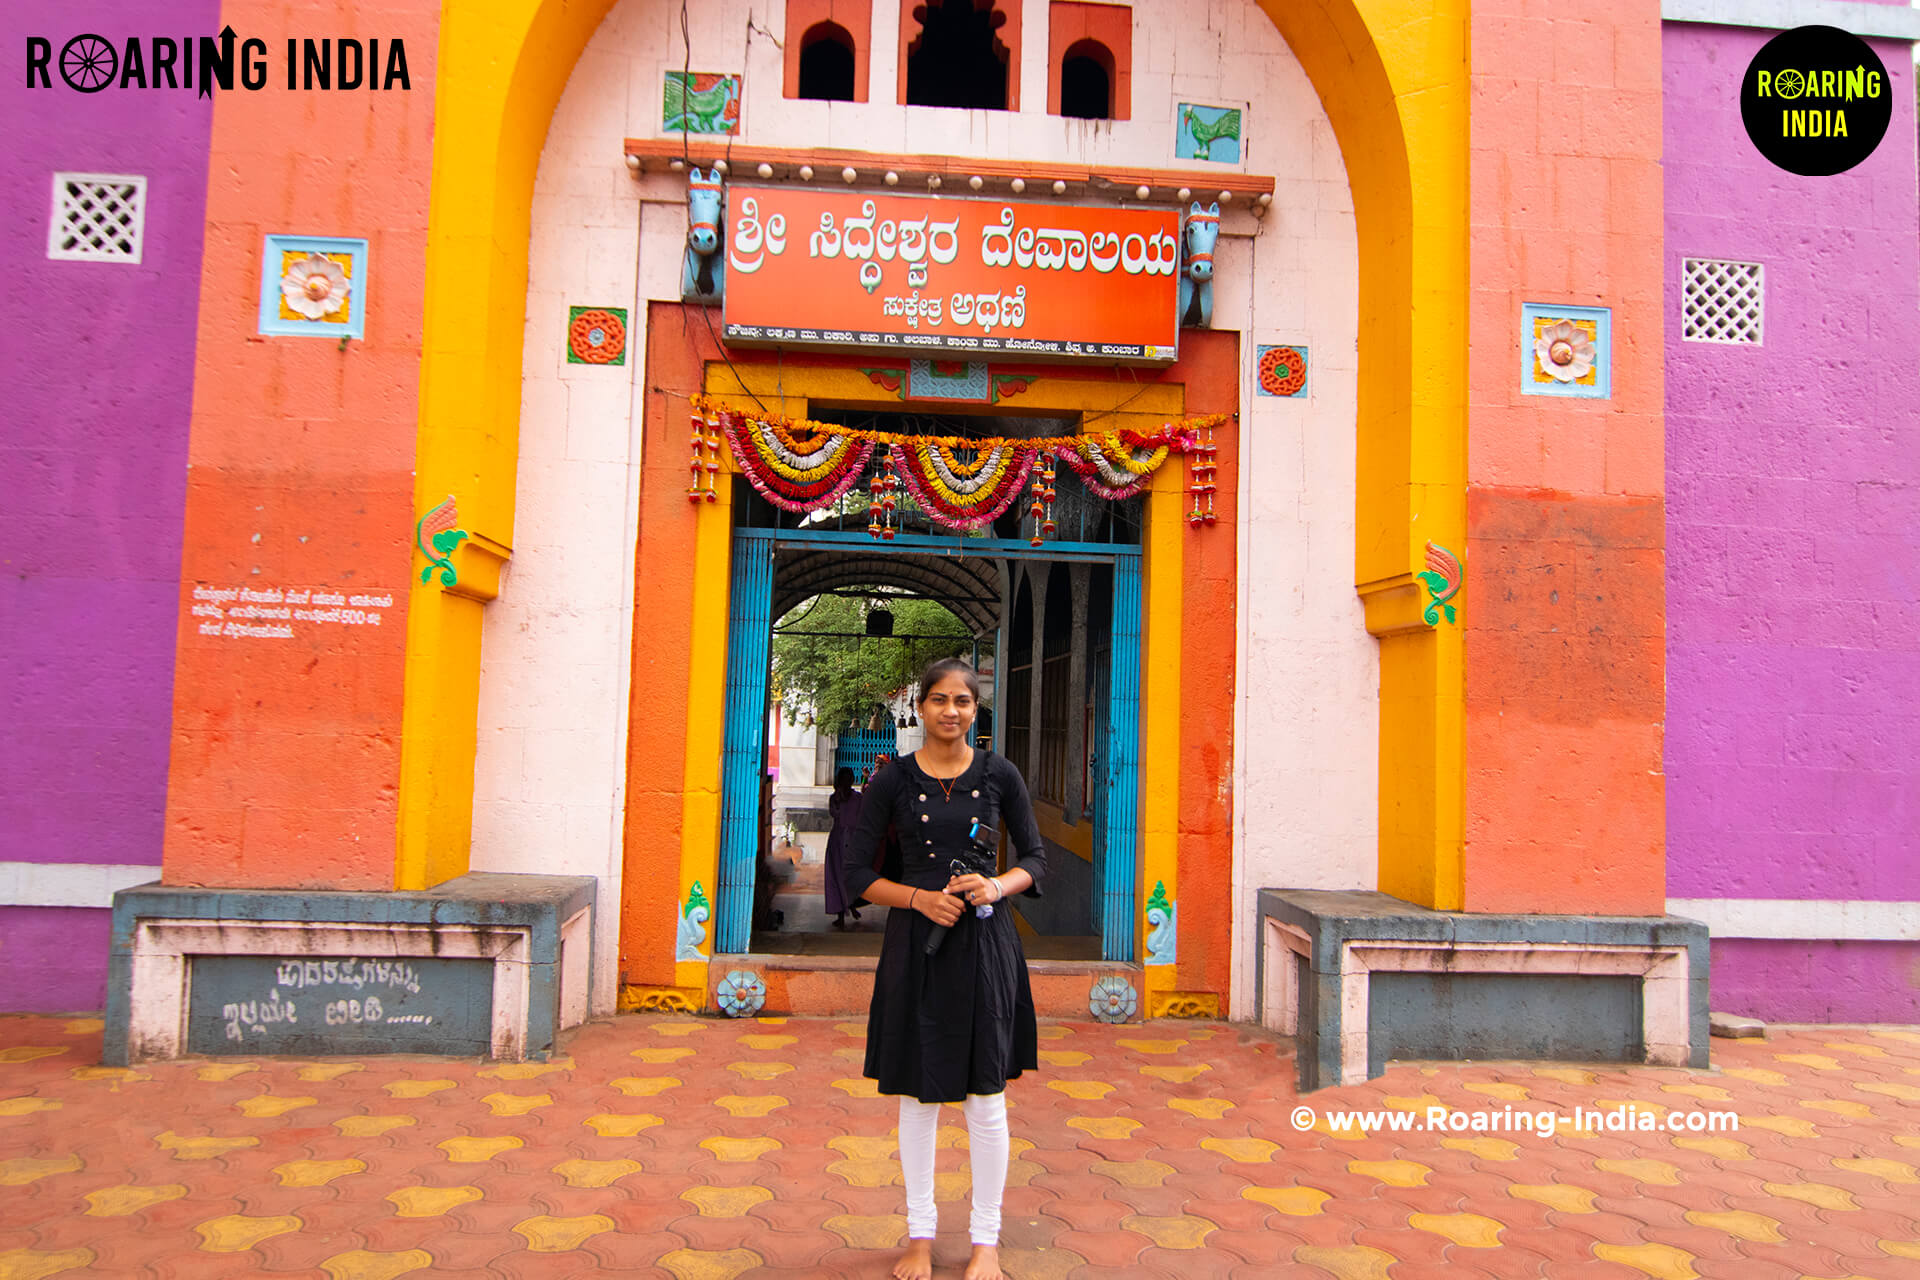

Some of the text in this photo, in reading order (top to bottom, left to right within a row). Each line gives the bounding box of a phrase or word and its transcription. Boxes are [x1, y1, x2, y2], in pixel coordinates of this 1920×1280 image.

[730, 197, 1178, 294] ಶ್ರೀ ಸಿದ್ಧೇಶ್ವರ ದೇವಾಲಯ
[883, 285, 1026, 334] ಸುಕ್ಷೇತ್ರ ಅಥಣಿ
